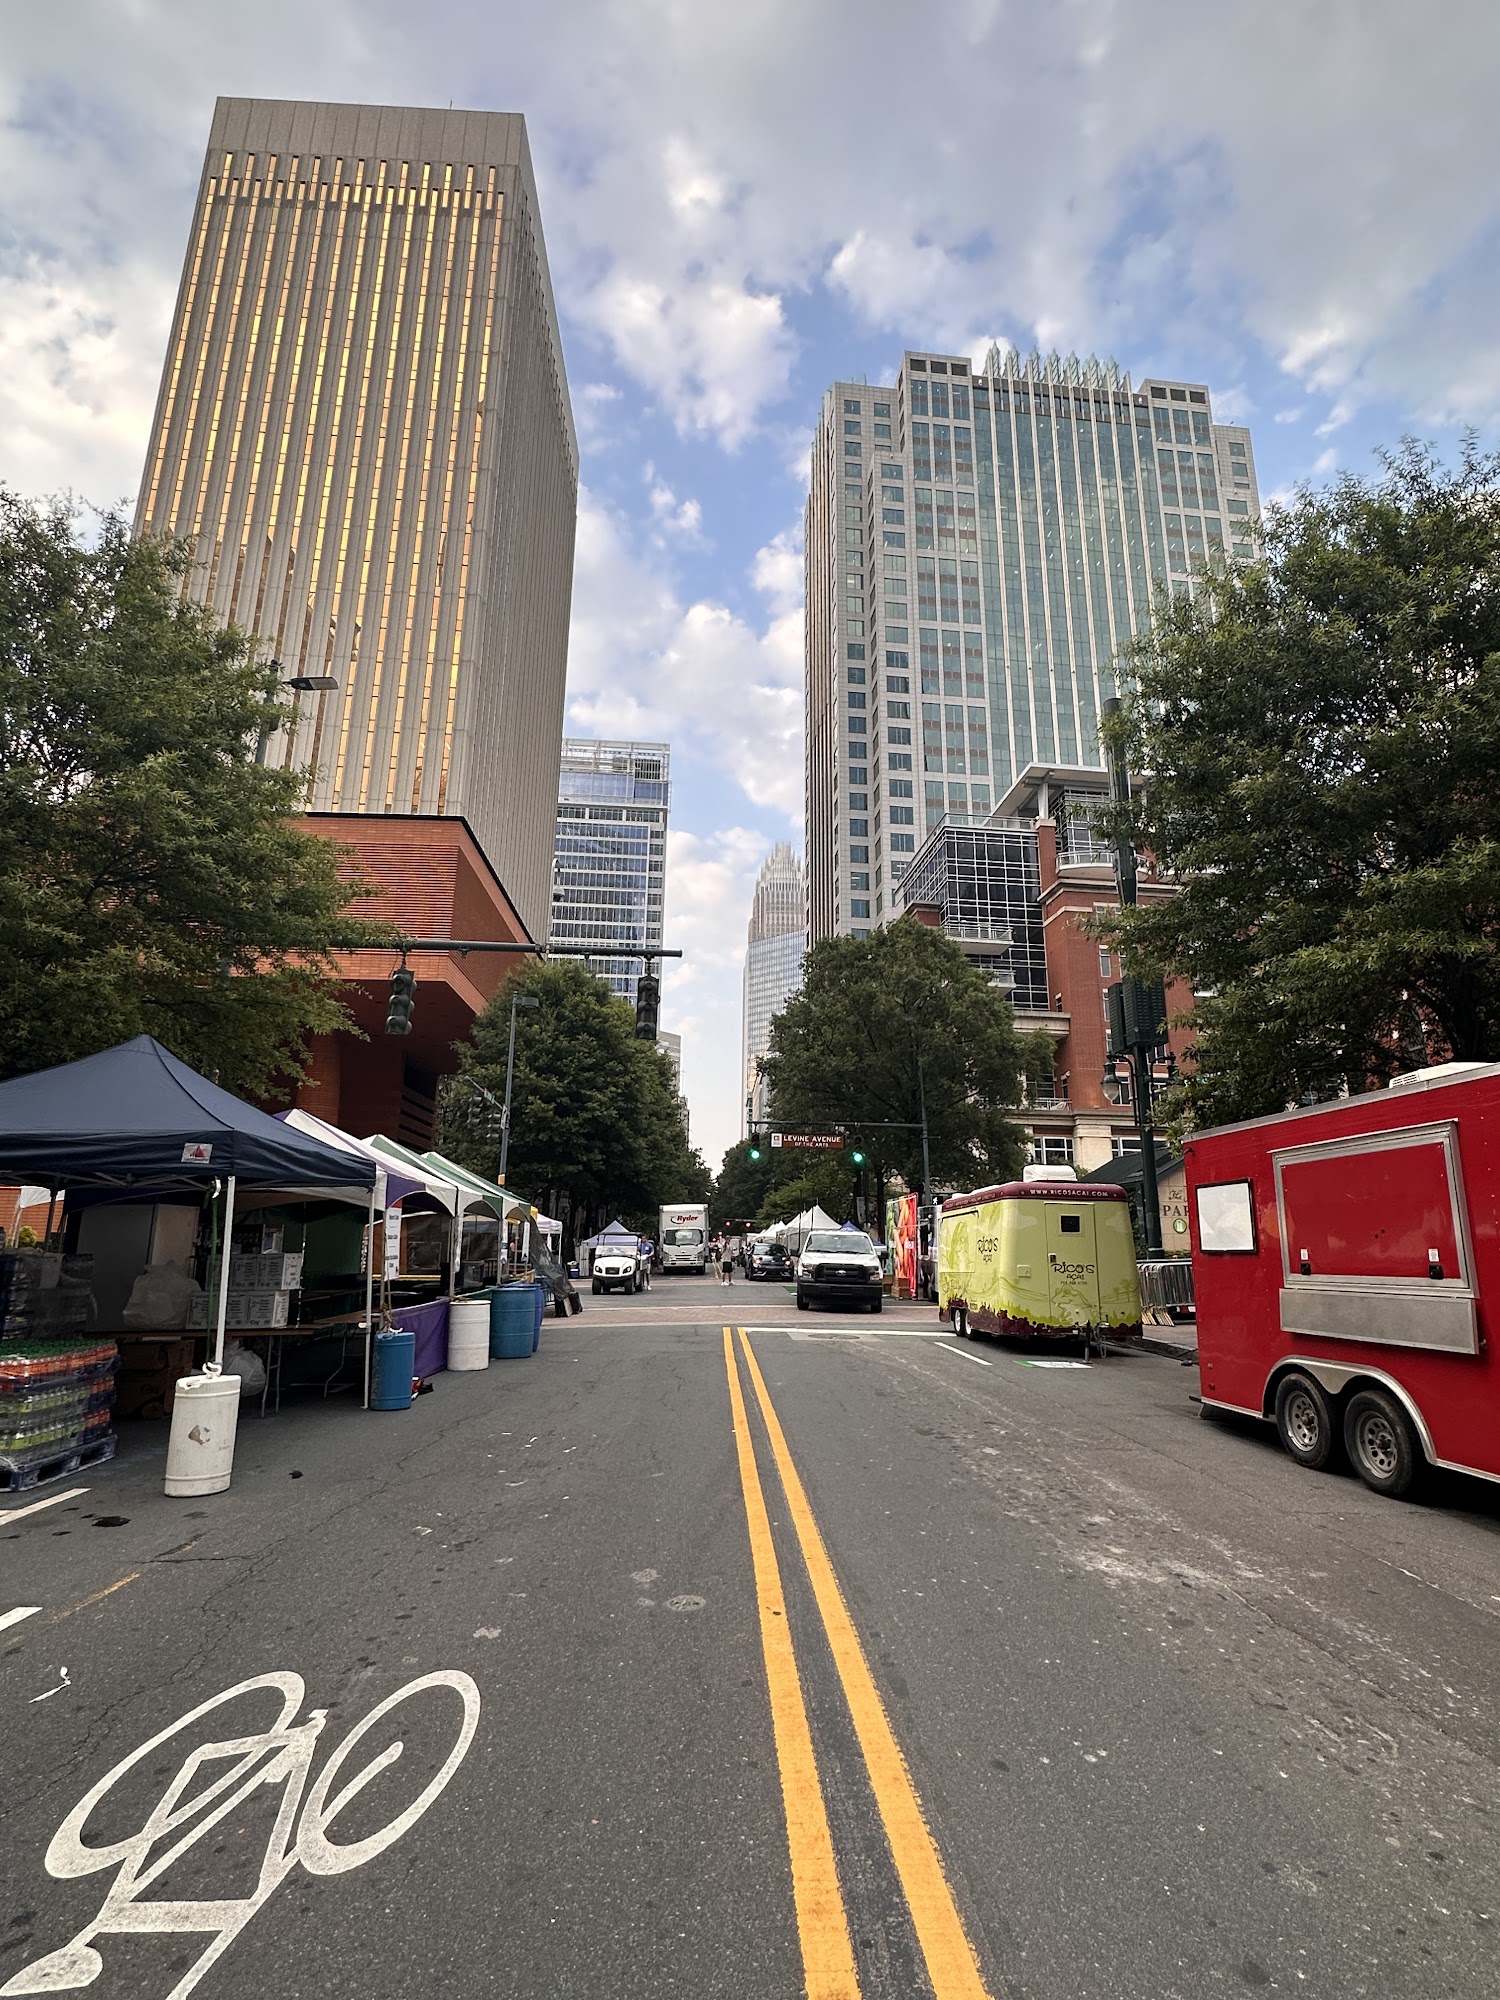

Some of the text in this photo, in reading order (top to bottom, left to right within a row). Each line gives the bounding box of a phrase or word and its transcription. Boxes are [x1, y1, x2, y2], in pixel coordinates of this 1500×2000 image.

[1029, 1189, 1109, 1197] WWW.RICOSACAI.COM
[1168, 1189, 1183, 1201] The
[676, 1214, 699, 1223] Ryder
